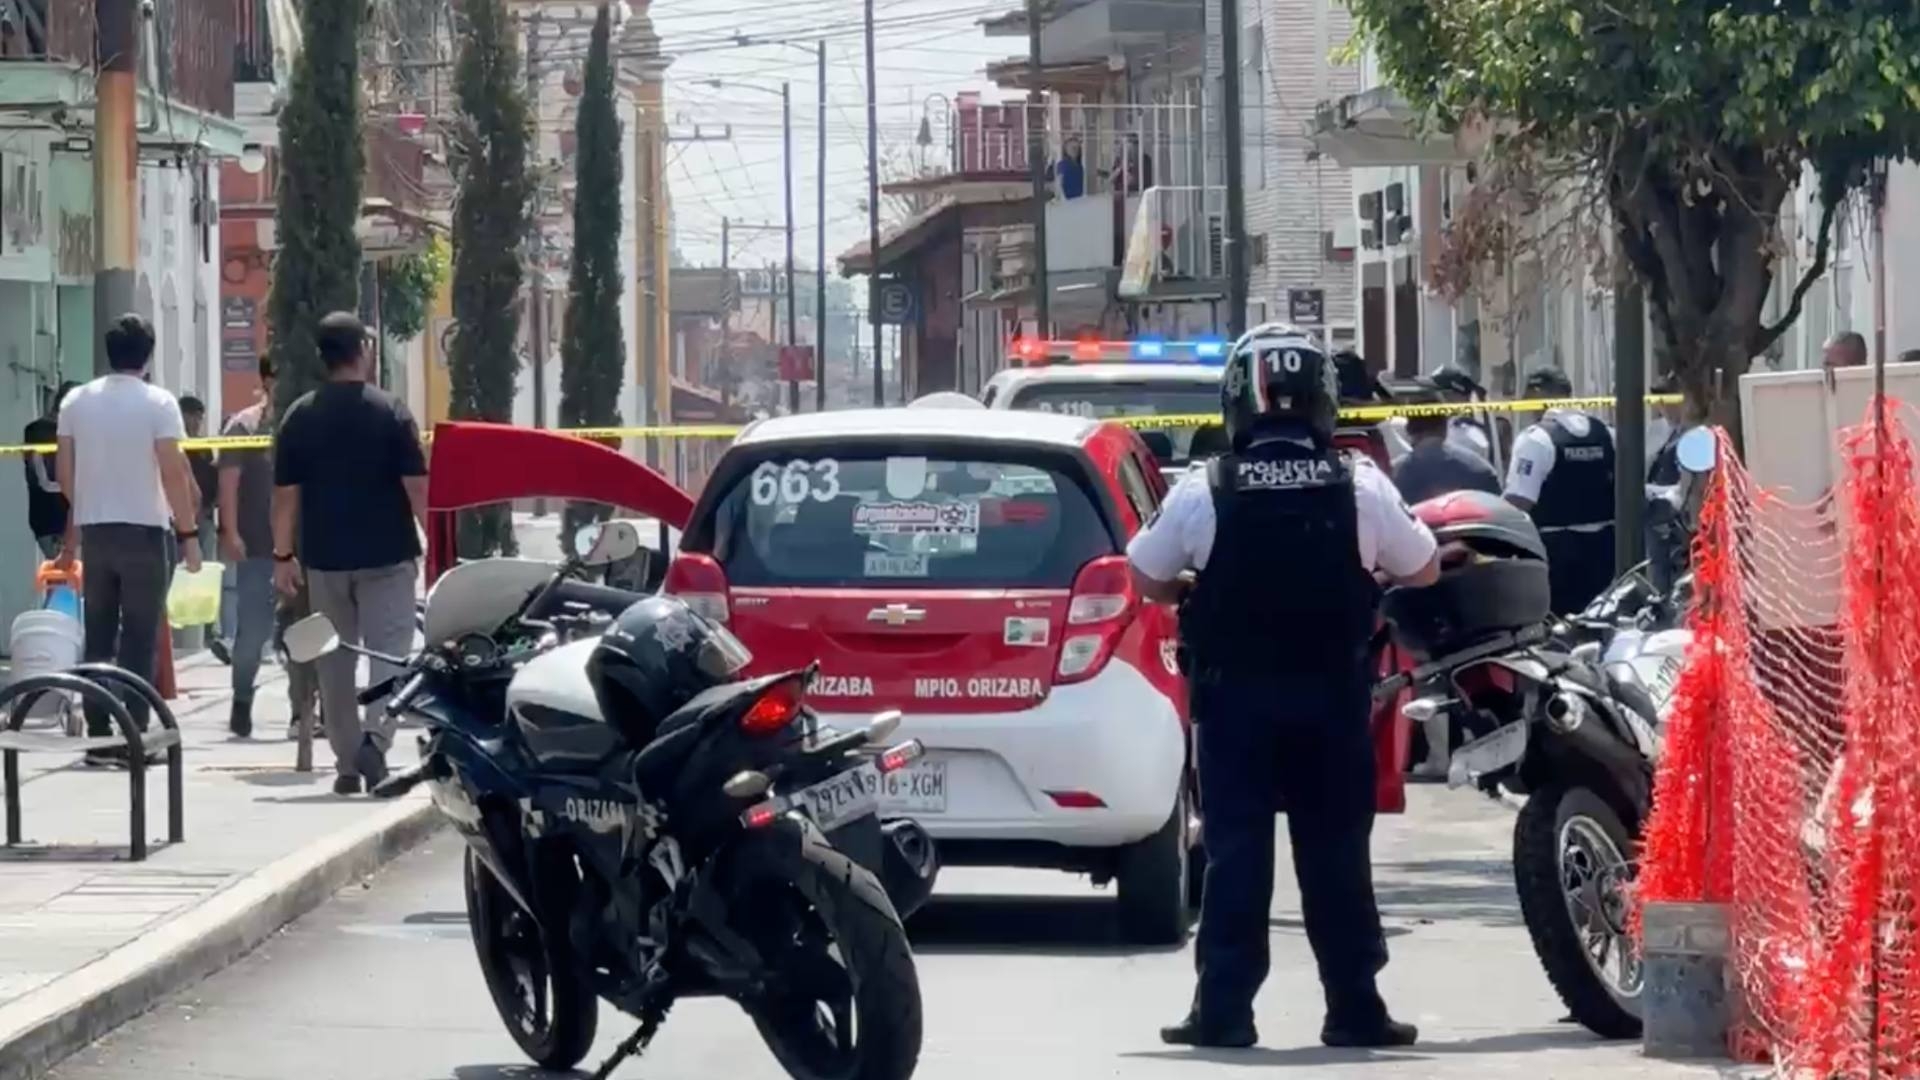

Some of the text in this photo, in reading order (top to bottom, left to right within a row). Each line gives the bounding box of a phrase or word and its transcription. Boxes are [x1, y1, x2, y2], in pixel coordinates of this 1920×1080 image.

[1265, 351, 1302, 373] 10
[1238, 459, 1332, 476] POLICIA
[1249, 470, 1326, 486] LOCAL
[752, 458, 839, 505] 663
[806, 675, 875, 697] RIZABA
[914, 677, 1045, 698] MPIO. ORIZABA
